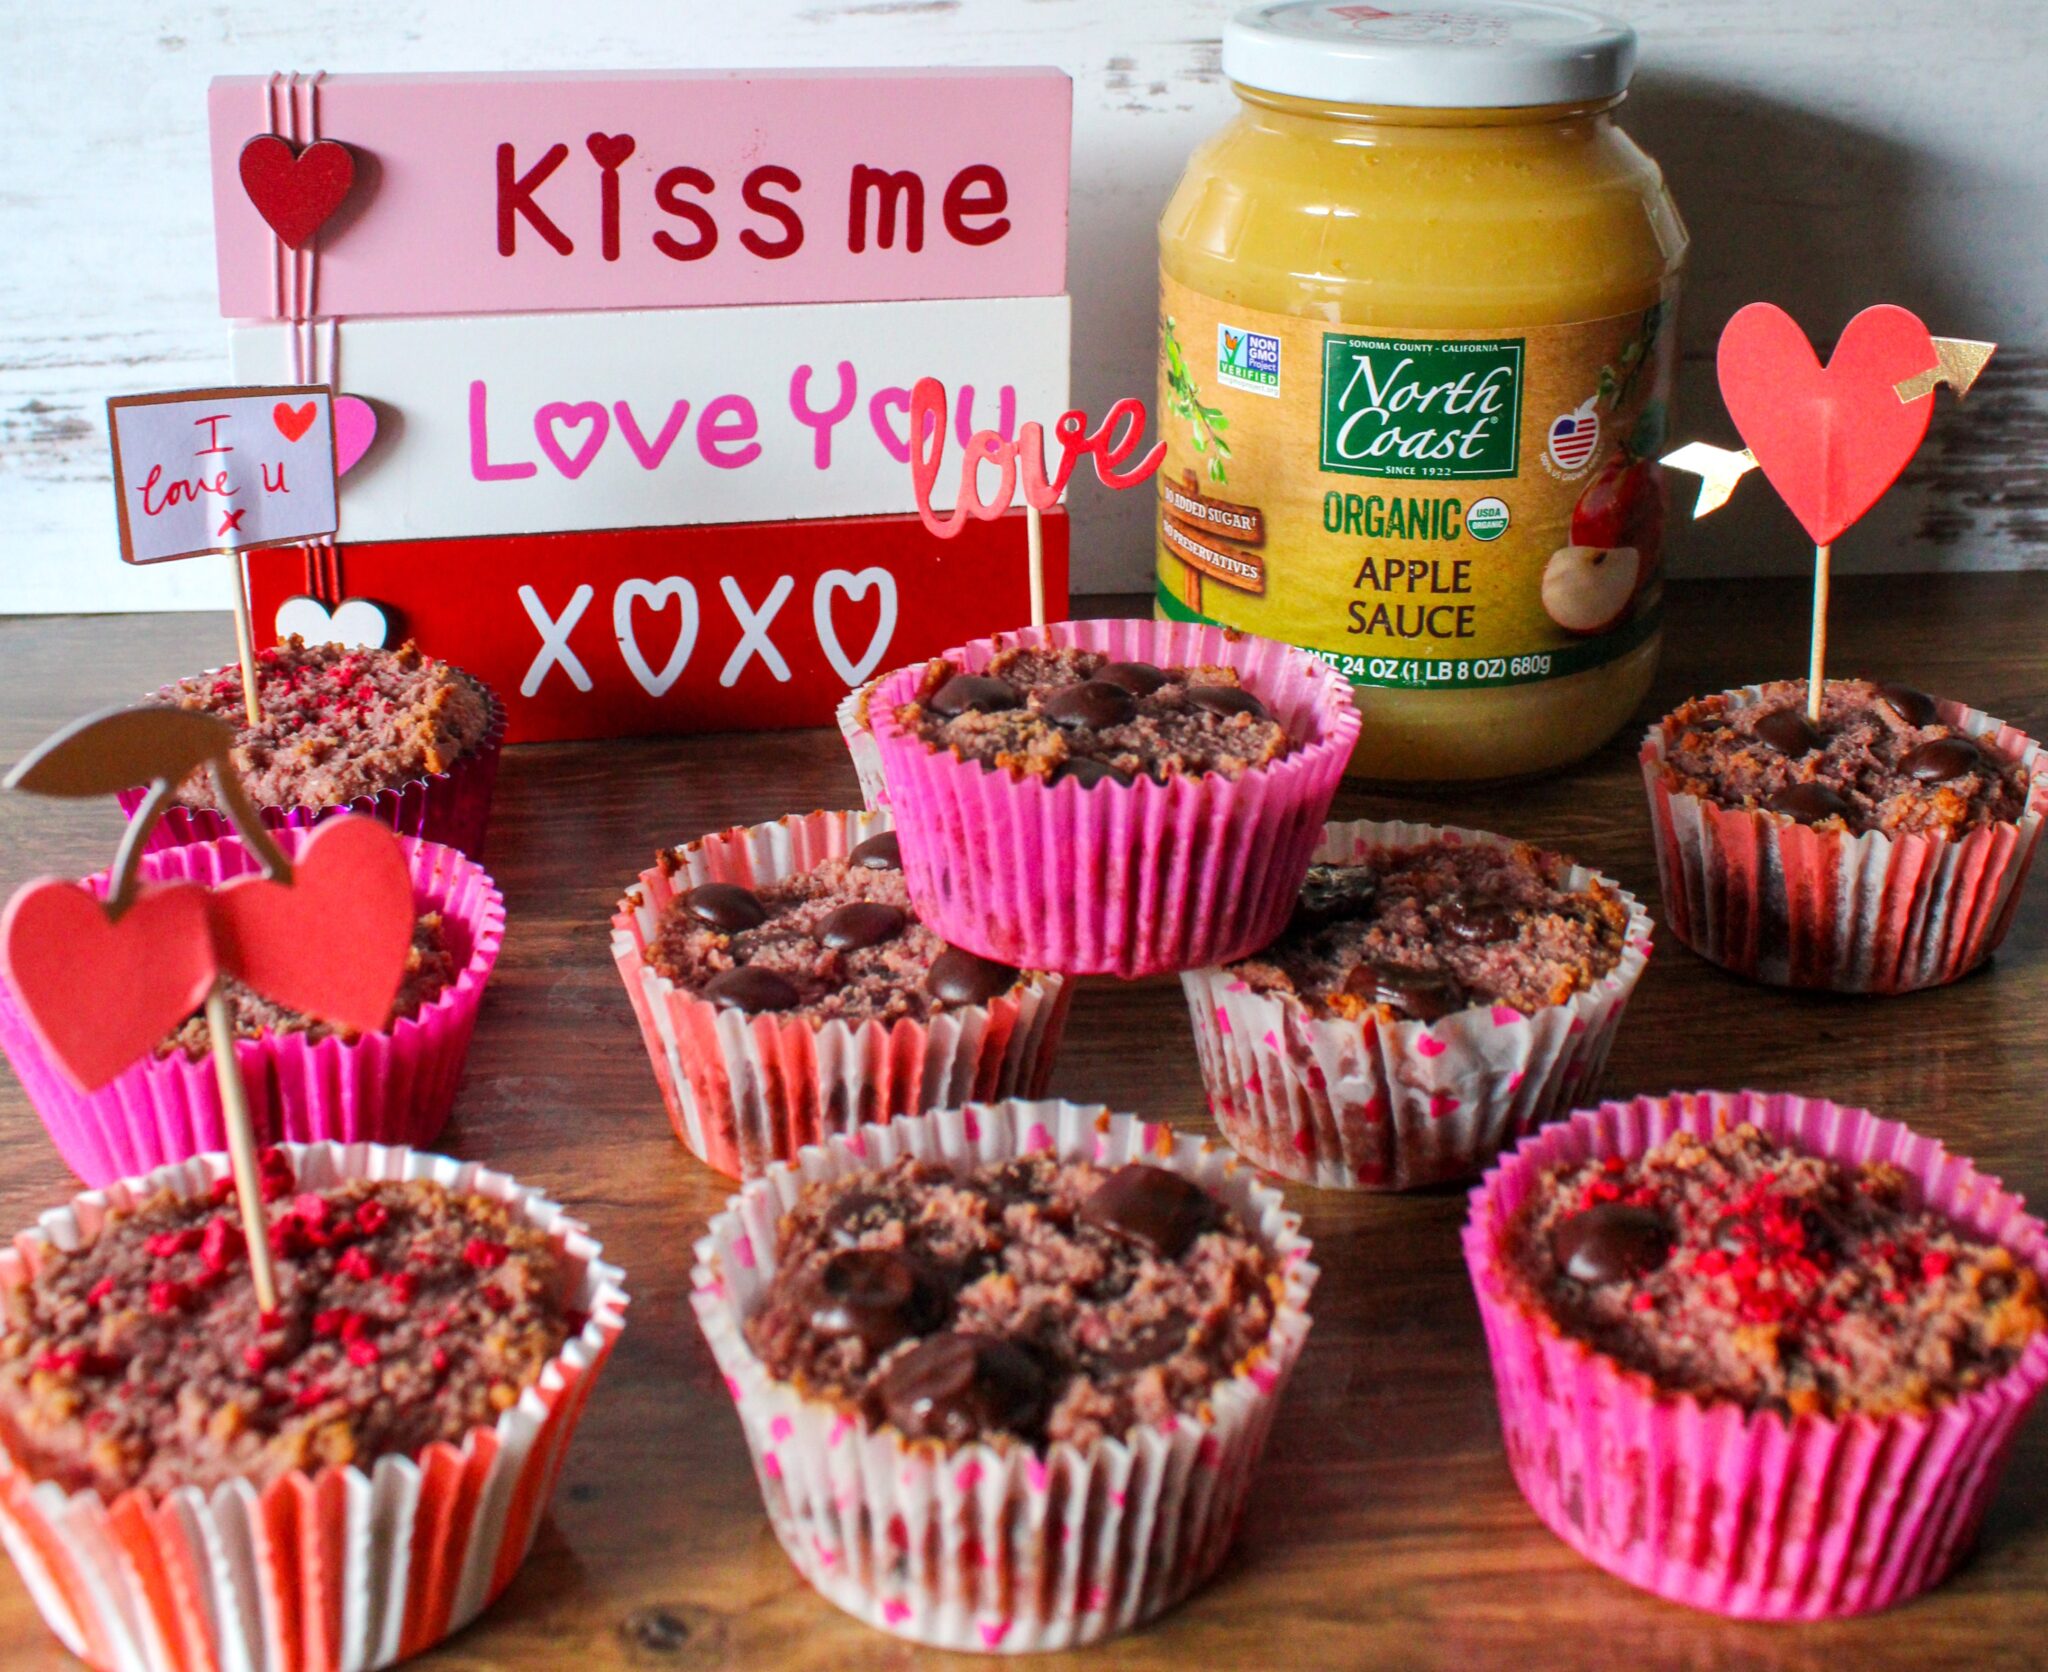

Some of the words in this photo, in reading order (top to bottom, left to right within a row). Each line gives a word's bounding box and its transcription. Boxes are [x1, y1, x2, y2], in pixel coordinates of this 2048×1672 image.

[496, 132, 804, 261] Kiss
[848, 163, 1011, 254] me
[1249, 336, 1277, 351] NON
[1249, 348, 1277, 363] GMO
[1349, 339, 1391, 351] SONOMA
[1393, 343, 1433, 352] COUNTY
[1442, 344, 1499, 353] CALIFORNIA
[1221, 362, 1276, 385] VERIFIED
[1249, 358, 1276, 372] Project
[1338, 355, 1512, 415] North
[194, 414, 234, 456] I
[469, 380, 762, 481] Love
[789, 360, 1016, 470] You
[910, 376, 1168, 539] love
[1385, 466, 1416, 475] SINCE
[1422, 467, 1452, 476] 1922
[136, 464, 241, 516] love
[1174, 493, 1206, 518] ADDED
[1323, 490, 1462, 541] ORGANIC
[1471, 520, 1504, 529] ORGANIC
[1476, 508, 1501, 518] USDA
[1173, 529, 1258, 579] PRESERVATIVES
[1353, 556, 1472, 594] APPLE
[1347, 600, 1476, 638] SAUCE
[1342, 656, 1364, 676] 24
[1369, 659, 1399, 679] OZ
[1402, 660, 1420, 680] (1
[1426, 661, 1453, 680] LB
[1457, 661, 1469, 680] 8
[1473, 658, 1507, 679] OZ)
[1510, 655, 1552, 676] 680g
